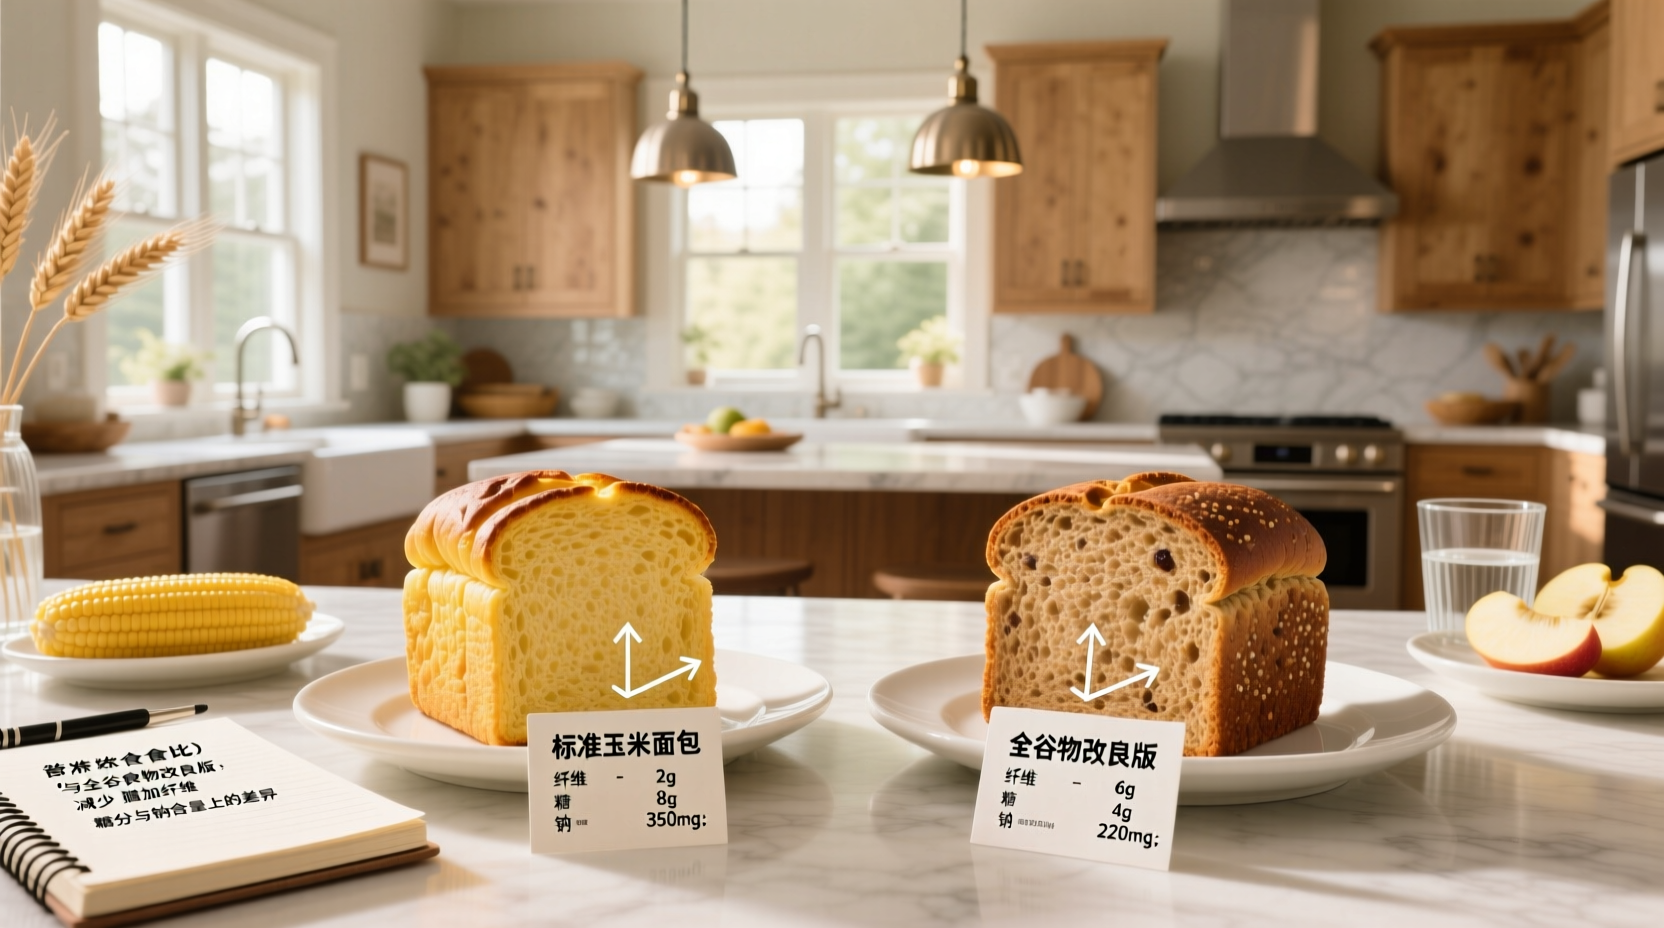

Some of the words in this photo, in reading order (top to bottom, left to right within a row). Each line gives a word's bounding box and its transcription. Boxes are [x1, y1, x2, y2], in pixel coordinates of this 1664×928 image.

[551, 729, 701, 760] 标准玉米面包
[1008, 731, 1158, 770] 全谷物改良版
[553, 770, 588, 789] 纤维
[656, 769, 676, 787] 2g
[1004, 767, 1038, 786] 纤维
[1115, 780, 1136, 800] 6g
[73, 794, 115, 812] 减少
[554, 794, 571, 810] 糖
[656, 790, 677, 809] 8g
[1001, 790, 1017, 807] 糖
[1112, 803, 1132, 822] 4g
[554, 814, 572, 833] 钠
[998, 811, 1013, 829] 钠
